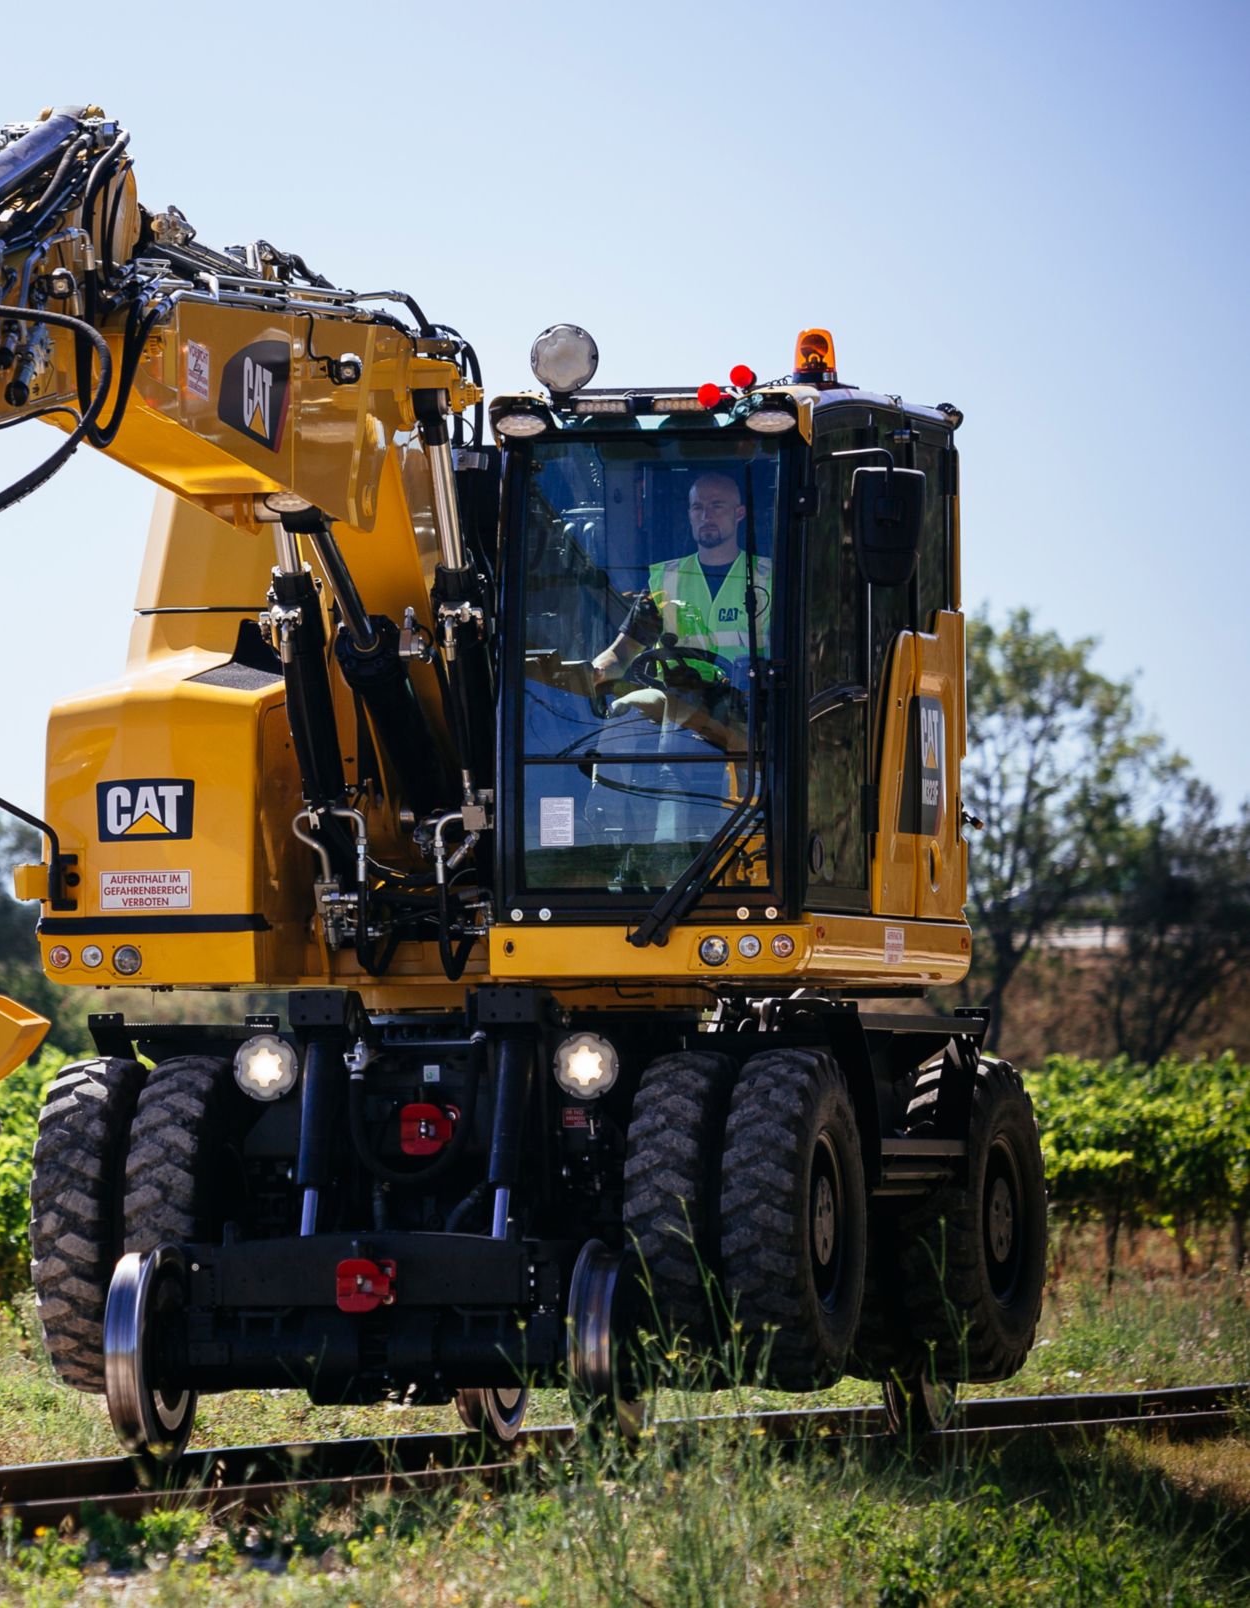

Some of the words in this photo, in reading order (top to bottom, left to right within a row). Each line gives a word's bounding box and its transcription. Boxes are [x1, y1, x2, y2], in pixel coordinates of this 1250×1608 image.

[243, 357, 272, 440] CAT
[719, 608, 738, 622] CAT
[920, 707, 939, 769] CAT
[106, 785, 183, 835] CAT
[110, 874, 167, 885] AUFENTHALT
[170, 874, 181, 883] IM
[104, 886, 188, 896] GEFAHRENBEREICH
[122, 897, 169, 907] VERBOTEN
